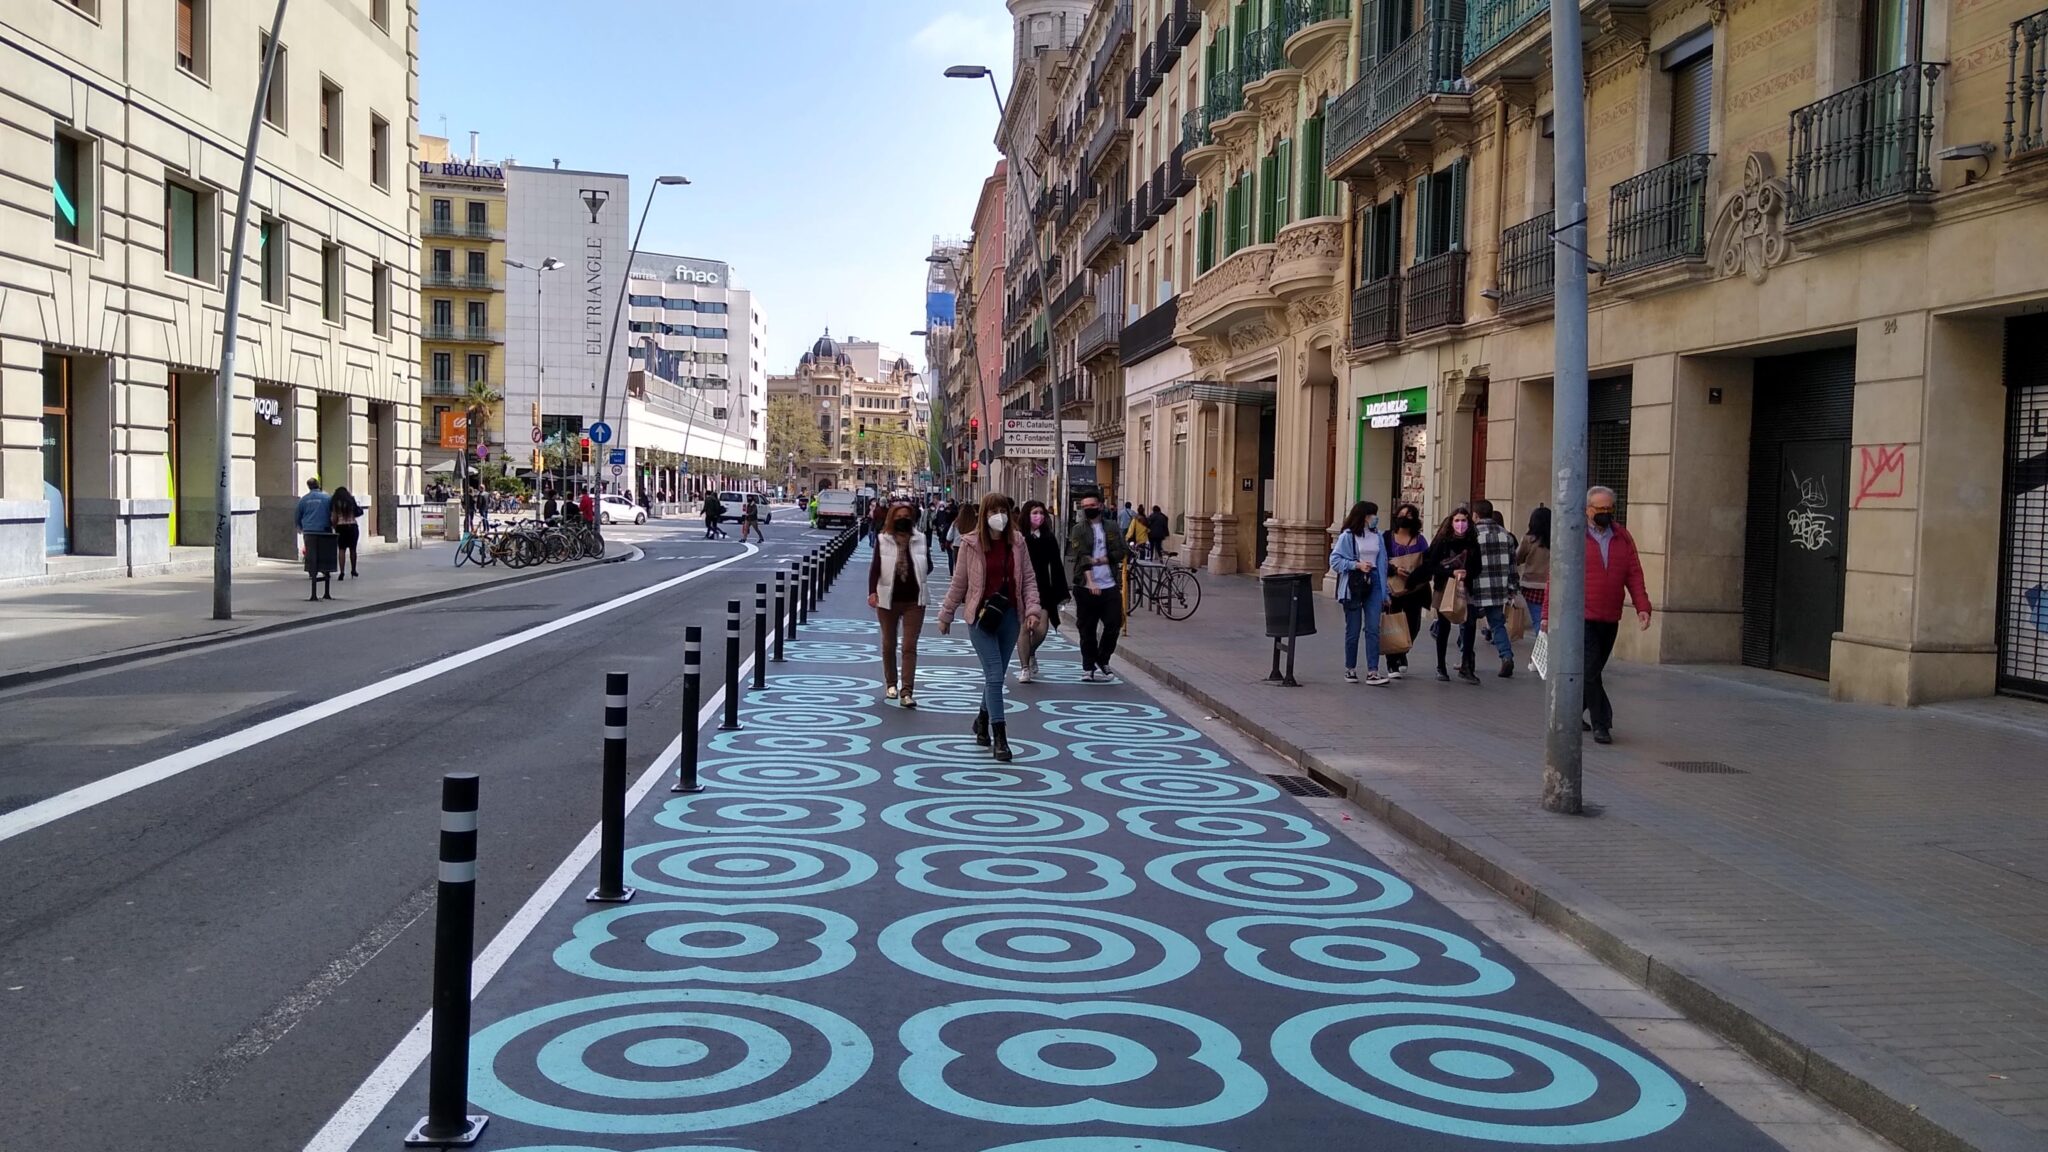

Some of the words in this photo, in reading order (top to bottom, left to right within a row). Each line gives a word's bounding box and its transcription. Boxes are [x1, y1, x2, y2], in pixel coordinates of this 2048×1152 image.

[442, 162, 505, 180] REGINA
[675, 264, 719, 284] fnac
[587, 237, 602, 330] TRIANGLE
[1884, 318, 1898, 335] 24
[1016, 421, 1024, 429] Pl.
[1026, 421, 1055, 430] Cataluny
[1015, 434, 1023, 442] C.
[1024, 434, 1056, 442] Fontanell
[1015, 447, 1026, 455] Via
[1027, 447, 1056, 455] Laietana
